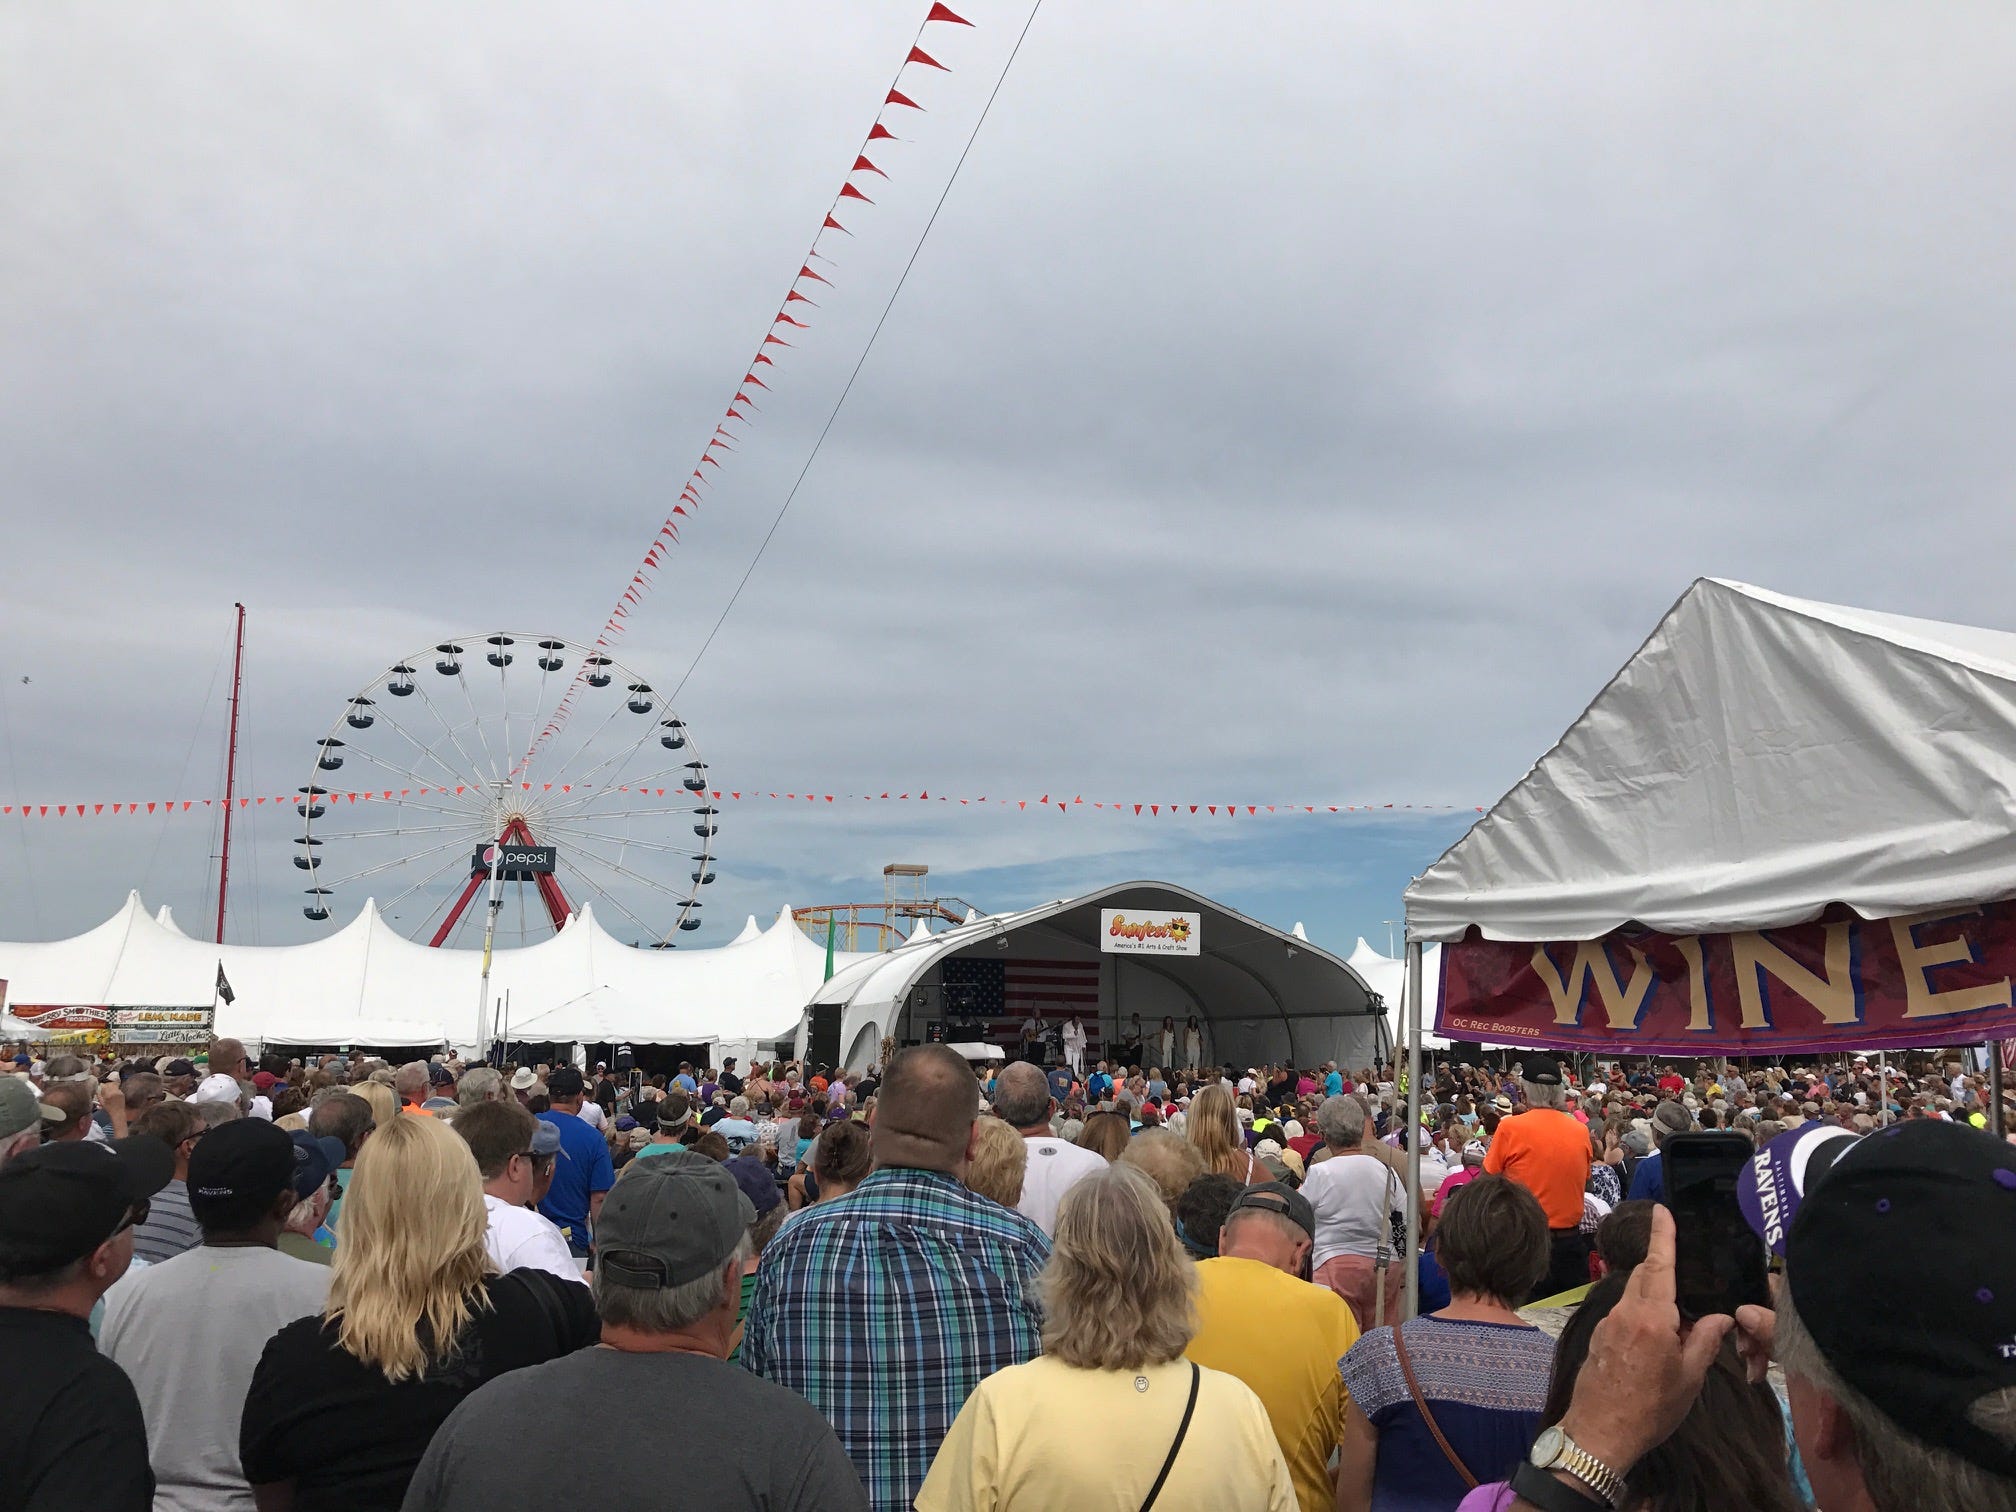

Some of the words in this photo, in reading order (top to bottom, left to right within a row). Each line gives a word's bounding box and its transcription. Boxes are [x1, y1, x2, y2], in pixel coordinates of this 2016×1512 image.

[505, 851, 547, 865] pepsi
[1109, 914, 1171, 941] Sunfest
[1529, 907, 2014, 1031] WINE
[138, 1012, 202, 1022] LEMONADE
[1452, 1018, 1468, 1028] OC
[1754, 1147, 1783, 1246] RAVENS
[1775, 1160, 1790, 1218] BALTIMORE
